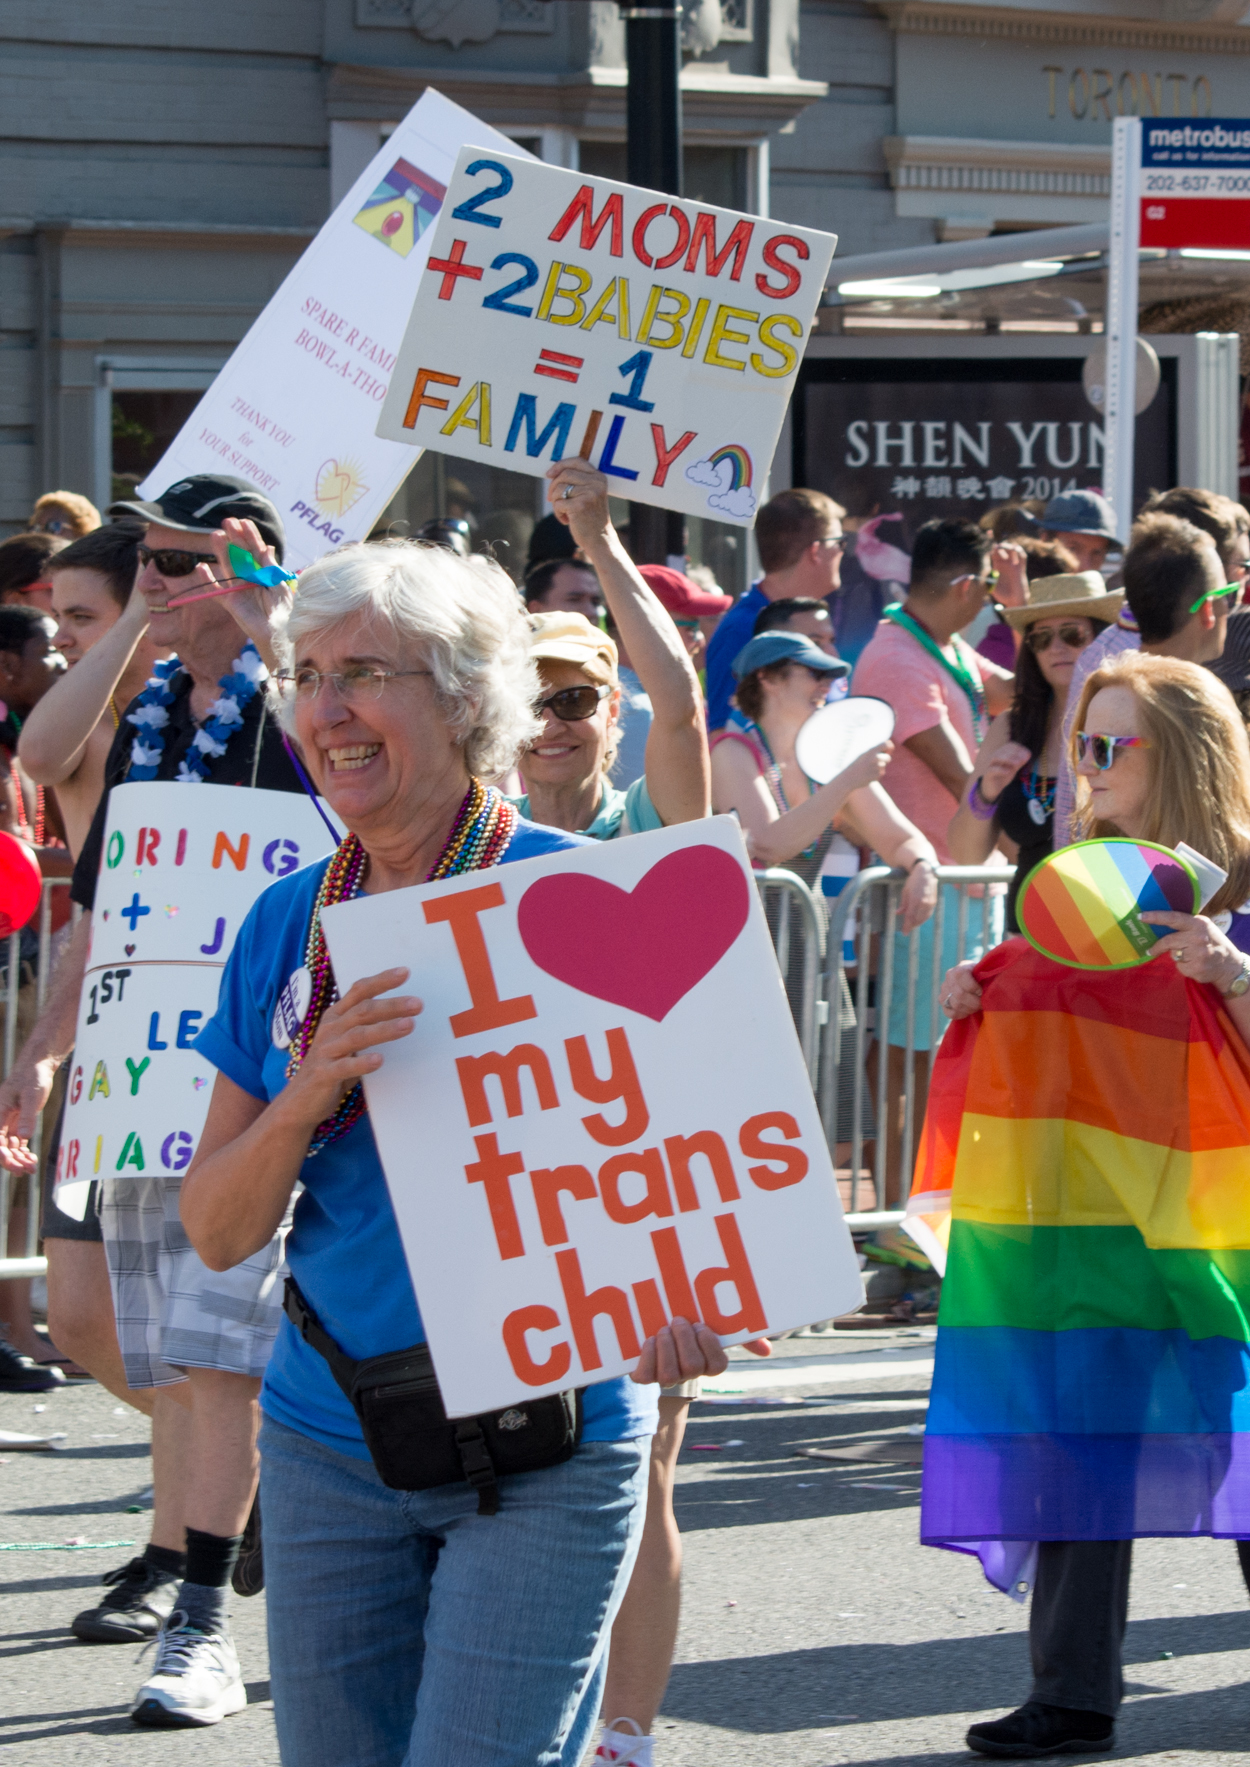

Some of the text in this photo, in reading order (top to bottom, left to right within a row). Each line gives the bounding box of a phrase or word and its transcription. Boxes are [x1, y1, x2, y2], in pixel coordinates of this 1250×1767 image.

[1041, 65, 1212, 121] TORONTO
[451, 159, 811, 299] 2 MOMS
[301, 296, 348, 338] SPARE
[345, 328, 360, 347] R
[294, 328, 388, 403] BOWL-A-THO
[608, 349, 656, 413] 1
[230, 396, 296, 449] THANK YOU
[237, 431, 254, 448] for
[402, 367, 699, 488] FAMILY
[845, 420, 993, 468] SHEN
[199, 427, 281, 493] YOUR SUPPORT
[1021, 476, 1078, 500] 2014
[290, 500, 344, 544] PFLAG
[104, 827, 300, 877] ORING
[121, 892, 226, 955] + J
[421, 882, 538, 1038] I
[87, 968, 132, 1025] 1ST
[147, 1009, 203, 1051] LE
[70, 1056, 151, 1106] GAY
[455, 1026, 650, 1147] my
[464, 1110, 809, 1260] trans
[502, 1212, 769, 1386] child
